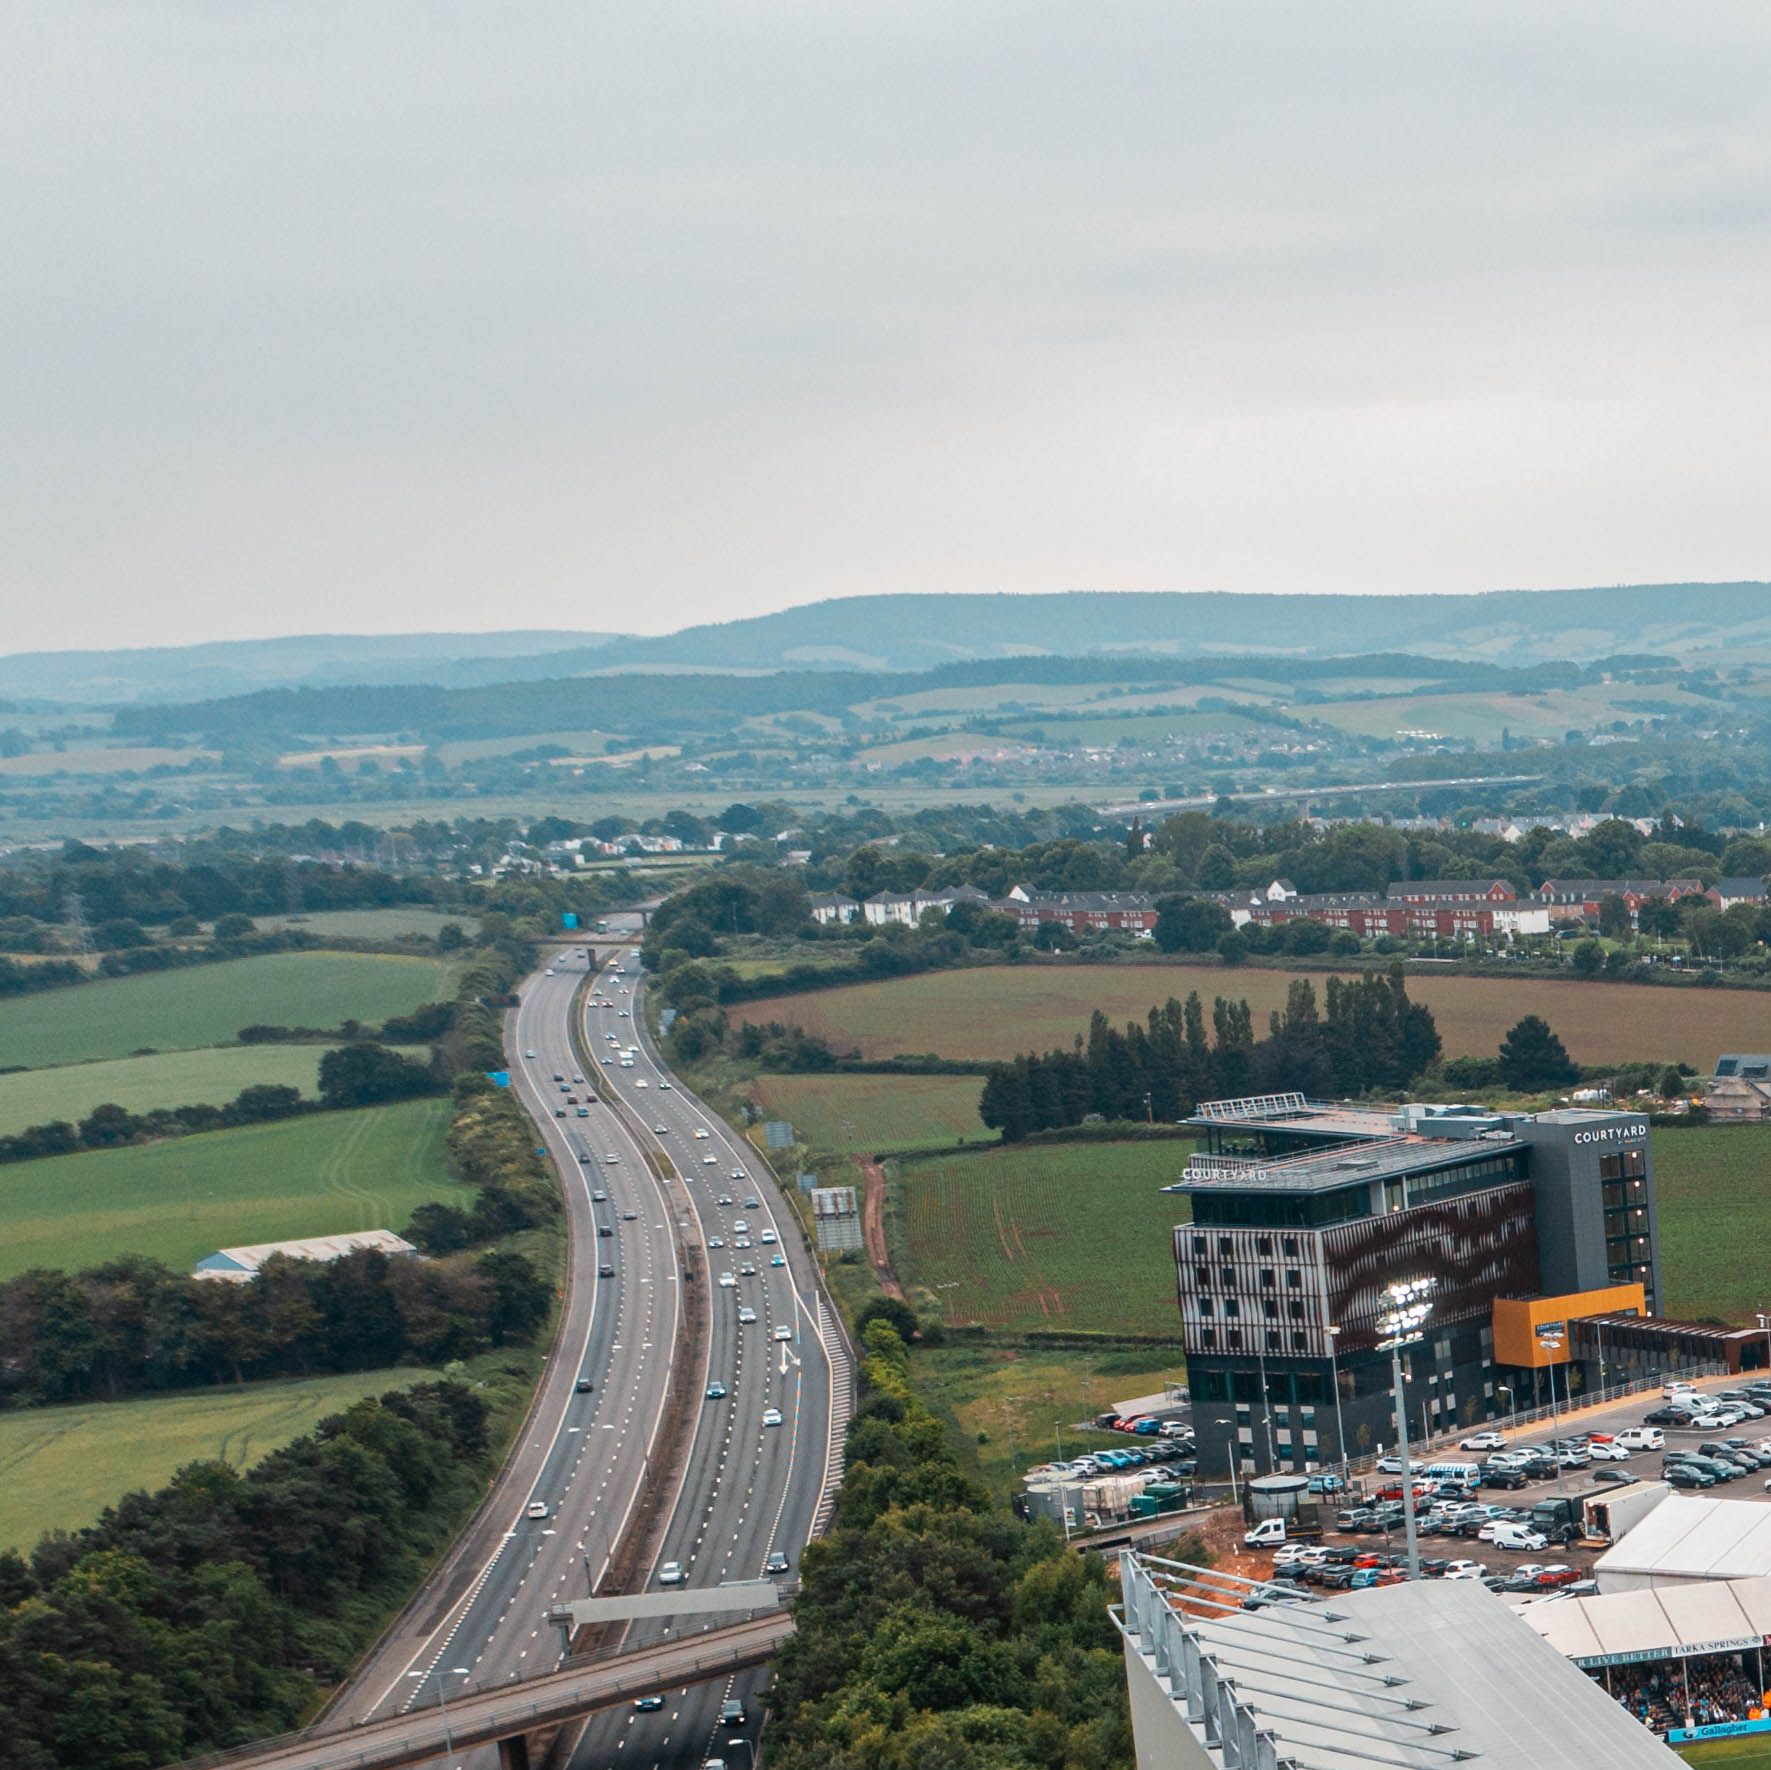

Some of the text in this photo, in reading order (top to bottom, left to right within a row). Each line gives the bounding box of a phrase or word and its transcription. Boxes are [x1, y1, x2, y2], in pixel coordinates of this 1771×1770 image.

[1574, 1124, 1647, 1144] COURTYARD
[1183, 1168, 1267, 1181] COURTYARD
[1675, 1638, 1749, 1655] TARKA SPRINGS
[1622, 1648, 1669, 1662] BETTER
[1700, 1722, 1748, 1737] Gallagher
